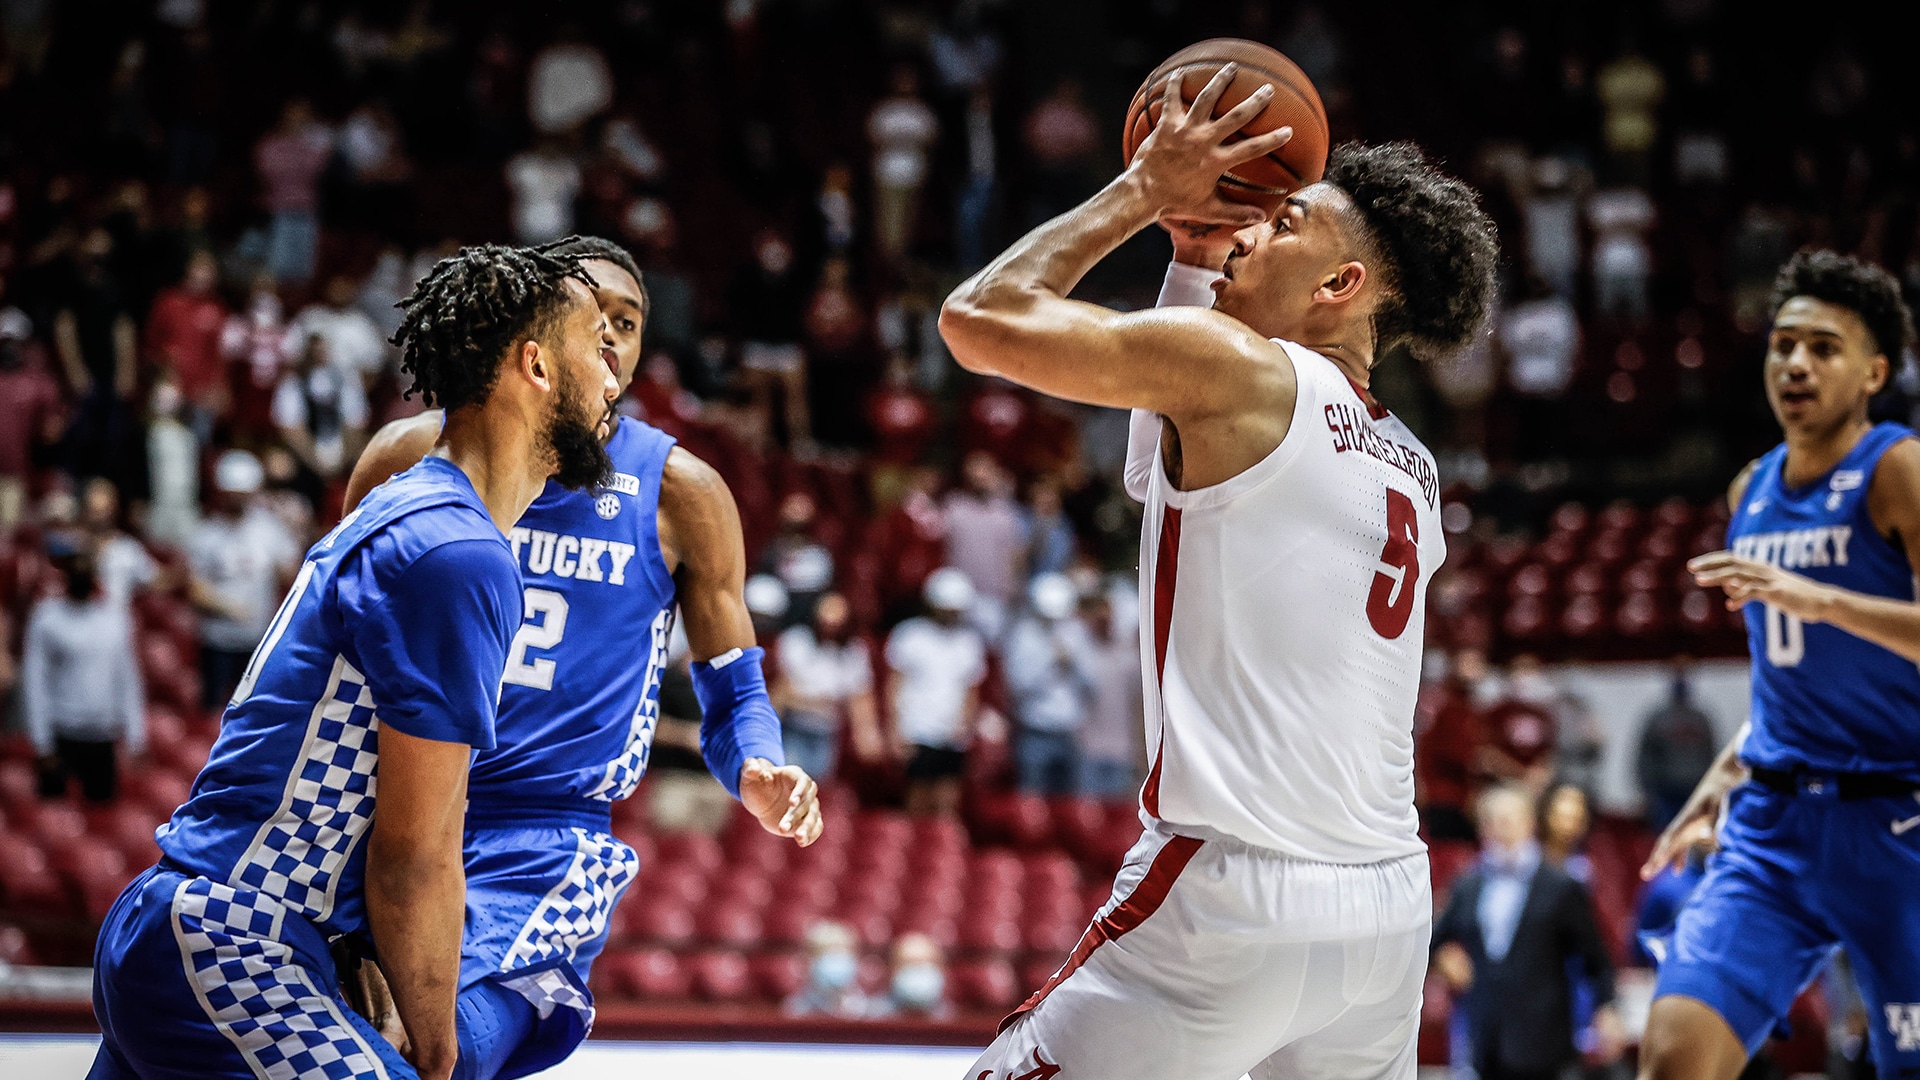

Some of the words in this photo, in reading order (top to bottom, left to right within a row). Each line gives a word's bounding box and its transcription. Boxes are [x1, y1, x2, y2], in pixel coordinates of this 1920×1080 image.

[508, 527, 635, 585] TUCKY
[1366, 487, 1419, 639] 5
[503, 587, 569, 691] 2
